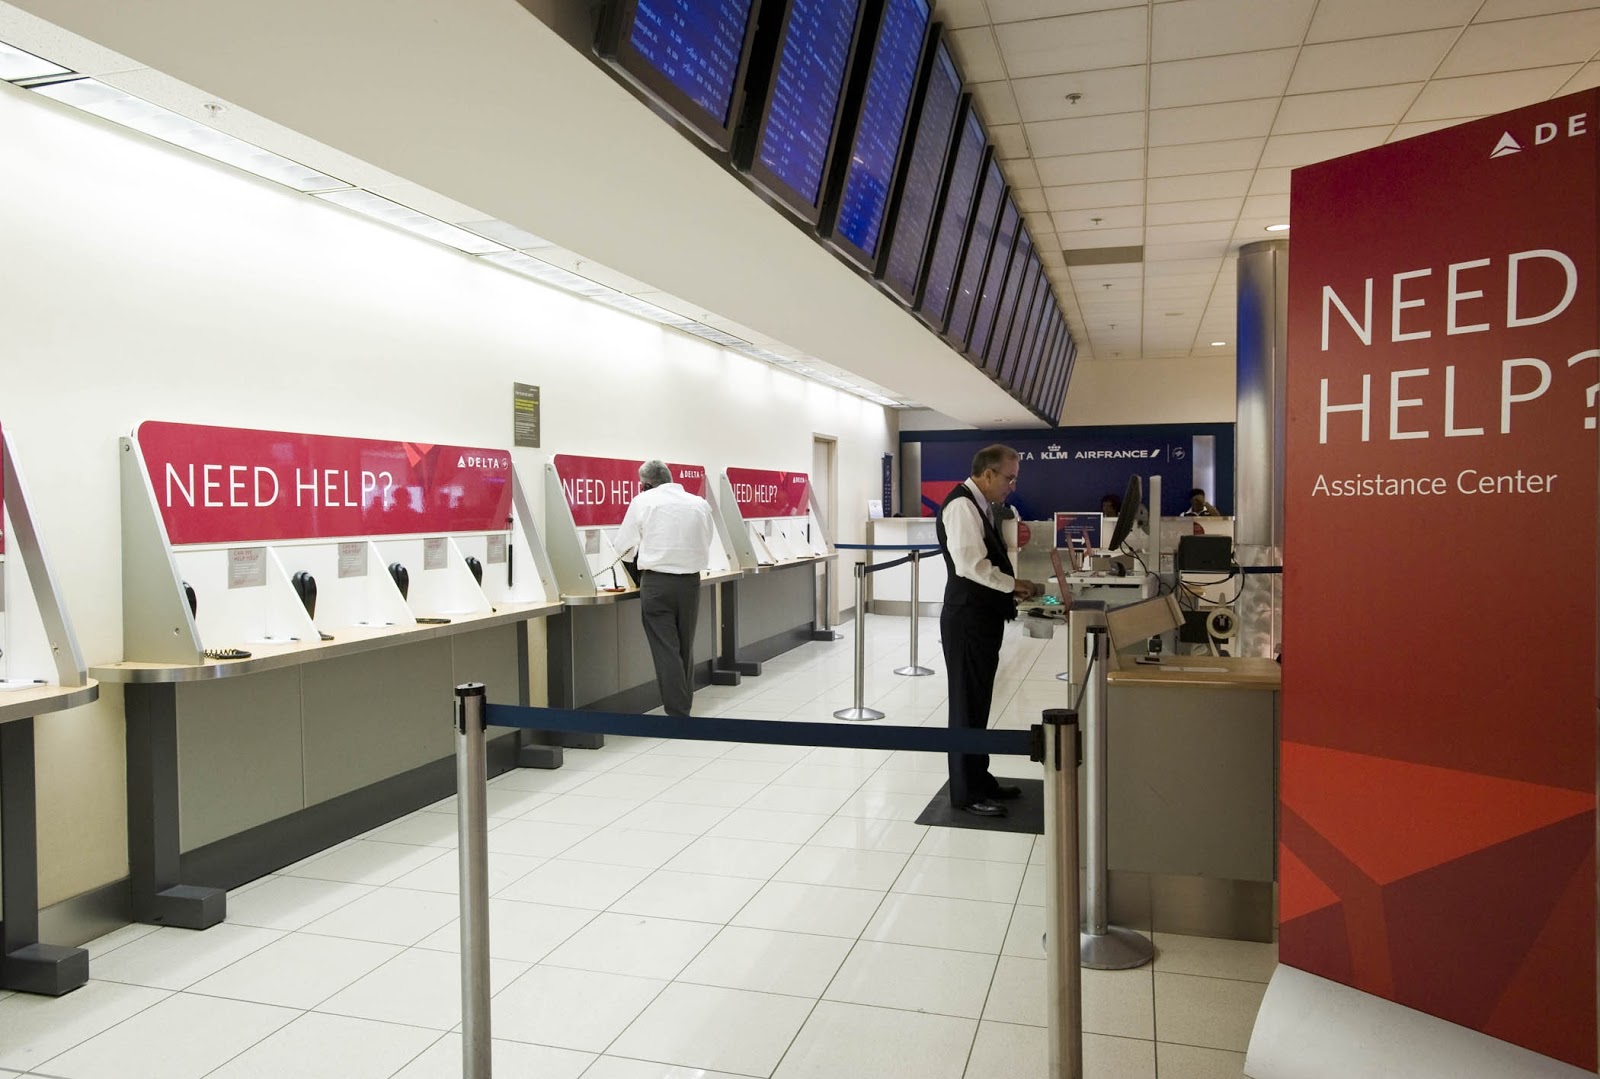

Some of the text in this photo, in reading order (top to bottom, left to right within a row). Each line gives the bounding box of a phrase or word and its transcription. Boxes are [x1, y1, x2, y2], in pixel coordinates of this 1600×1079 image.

[1320, 248, 1579, 352] NEED
[1318, 348, 1600, 445] HELP?
[467, 456, 500, 469] DELTA
[1040, 451, 1068, 460] KLM
[1074, 450, 1148, 459] AIRFRANCE
[164, 462, 393, 509] NEED HELP?
[562, 477, 606, 505] NEED
[754, 483, 778, 503] HELP?
[1311, 469, 1558, 497] Assistance Center
